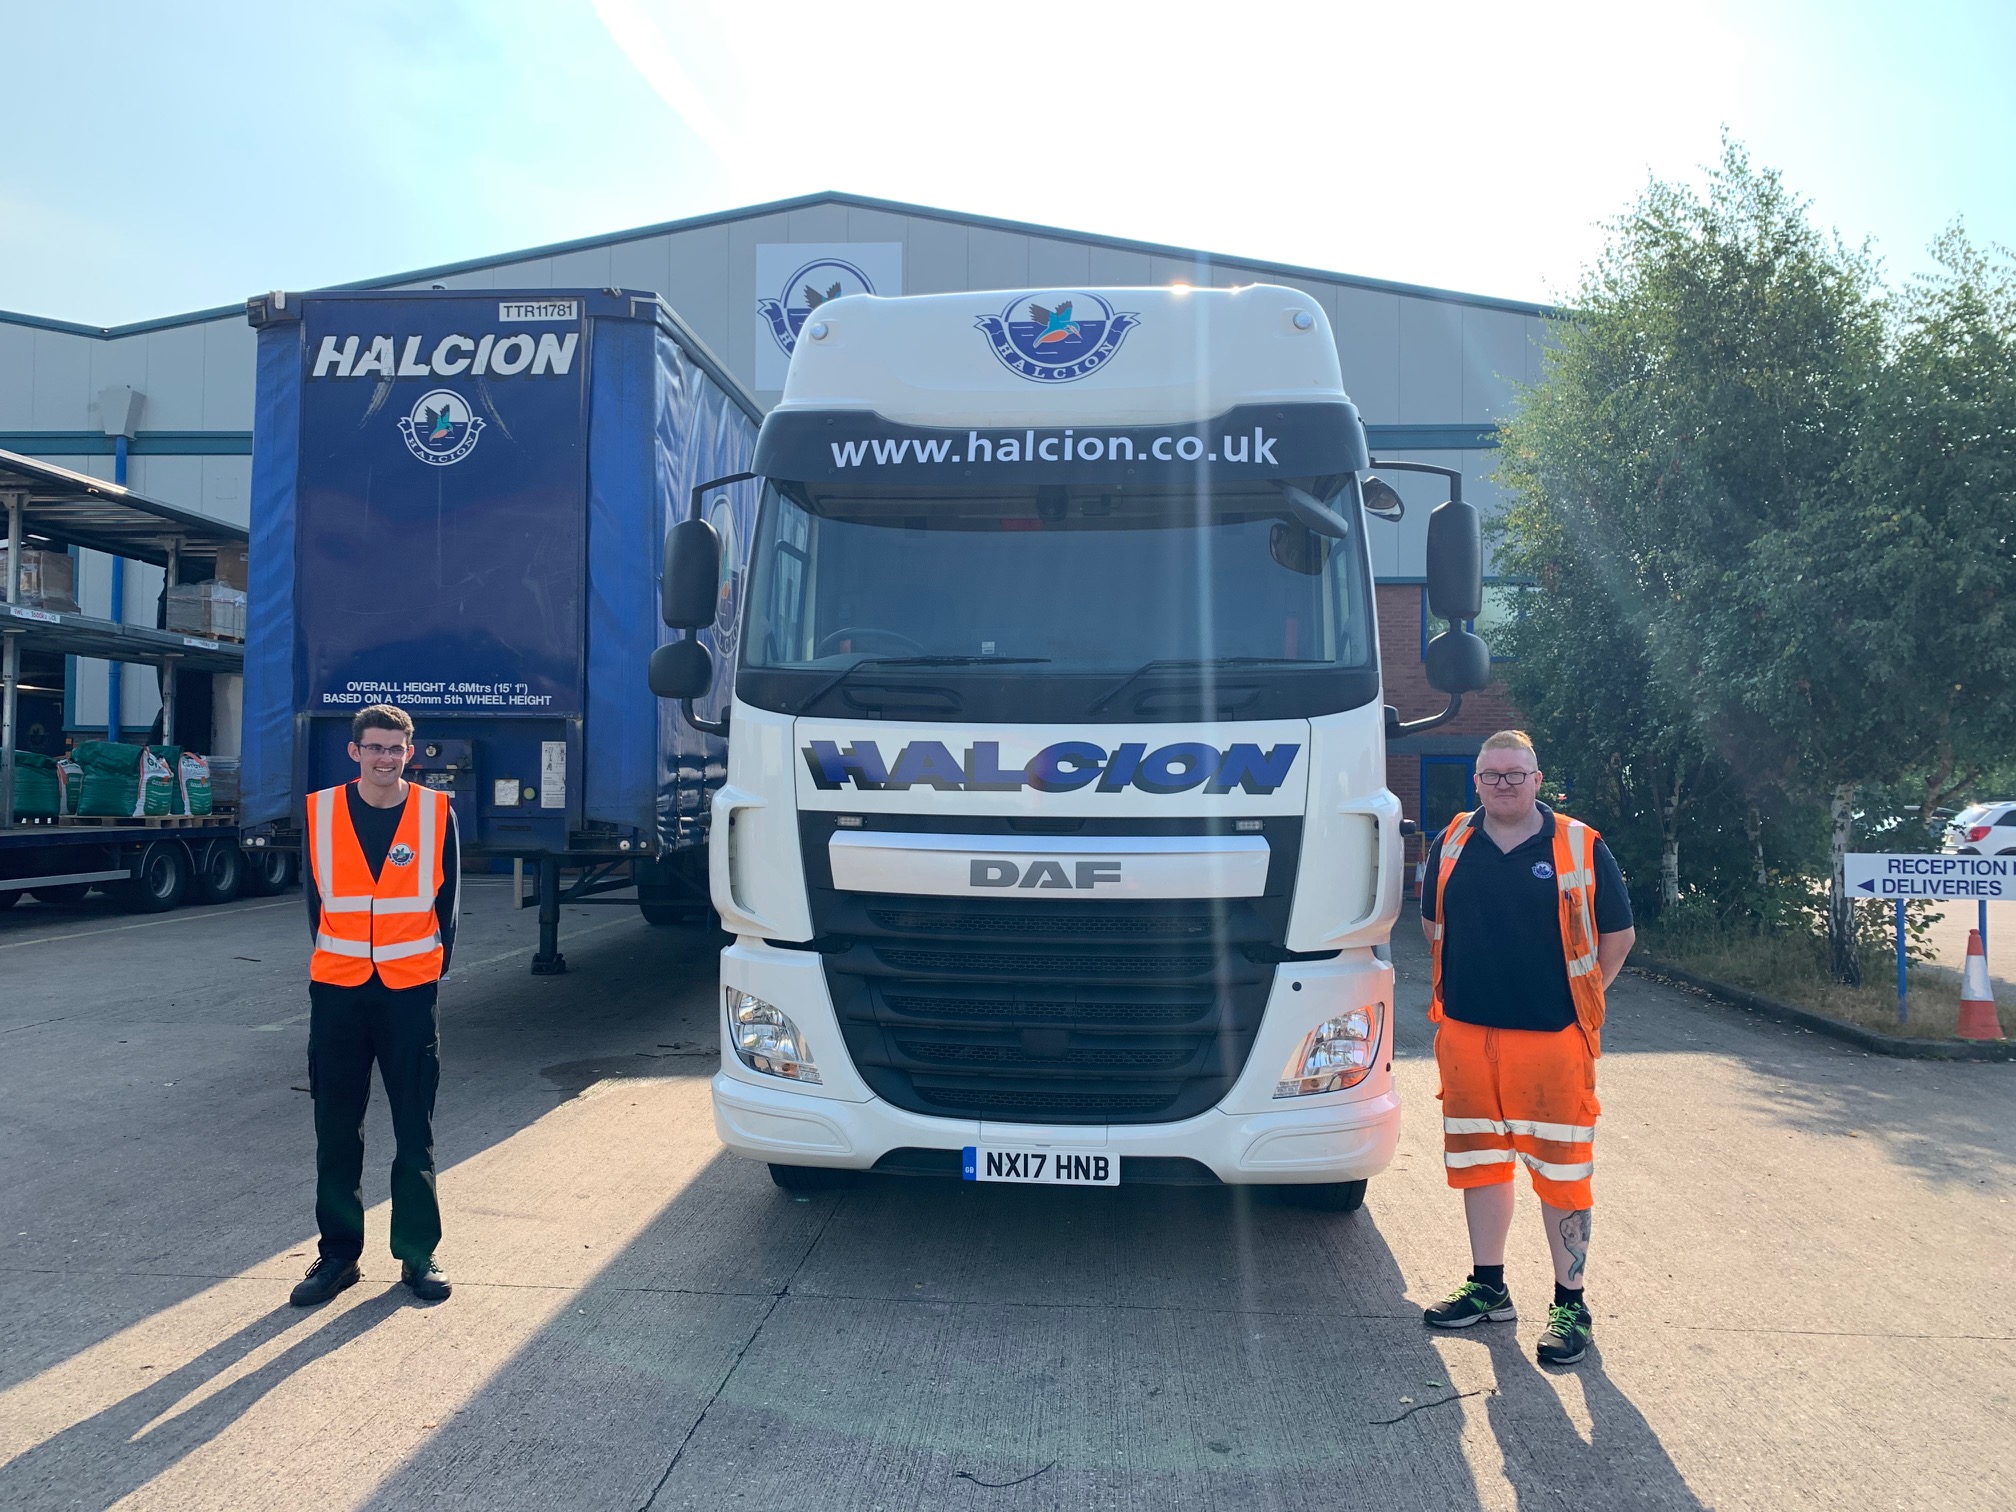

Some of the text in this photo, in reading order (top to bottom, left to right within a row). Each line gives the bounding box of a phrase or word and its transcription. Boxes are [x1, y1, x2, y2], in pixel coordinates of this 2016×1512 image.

[503, 303, 572, 318] TTR11781
[311, 332, 579, 378] HALCION
[997, 340, 1115, 379] HALCION
[407, 436, 474, 463] HALCION
[830, 426, 1279, 469] www.halcion.co.uk
[323, 693, 552, 706] BASED ON A 1250mm 5th WHEEL HEIGHT
[346, 681, 401, 692] OVERALL
[403, 682, 446, 693] HEIGHT
[448, 682, 492, 694] 4.6Mtrs
[801, 740, 1302, 795] HALCION
[969, 858, 1122, 889] DAF
[1888, 858, 2007, 876] RECEPTION
[1882, 878, 2003, 896] DELIVERIES
[964, 1166, 975, 1174] GB
[986, 1151, 1110, 1181] NX17 HNB
